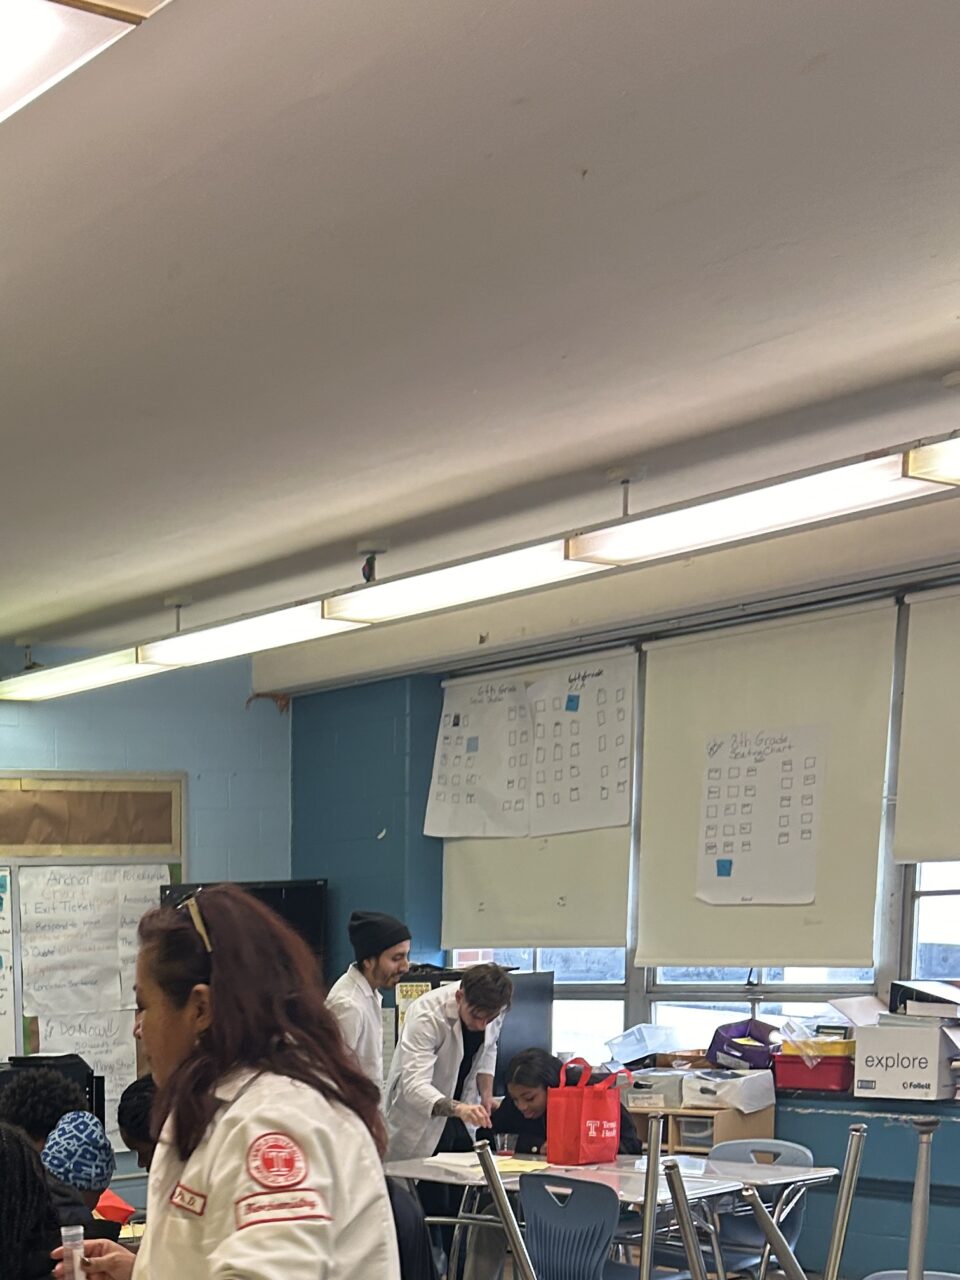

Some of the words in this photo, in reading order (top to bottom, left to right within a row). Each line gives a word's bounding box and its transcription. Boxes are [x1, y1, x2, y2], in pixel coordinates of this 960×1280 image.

[756, 730, 789, 746] Grade
[47, 871, 90, 886] Anchor
[34, 903, 57, 914] Exit
[865, 1052, 928, 1072] explore
